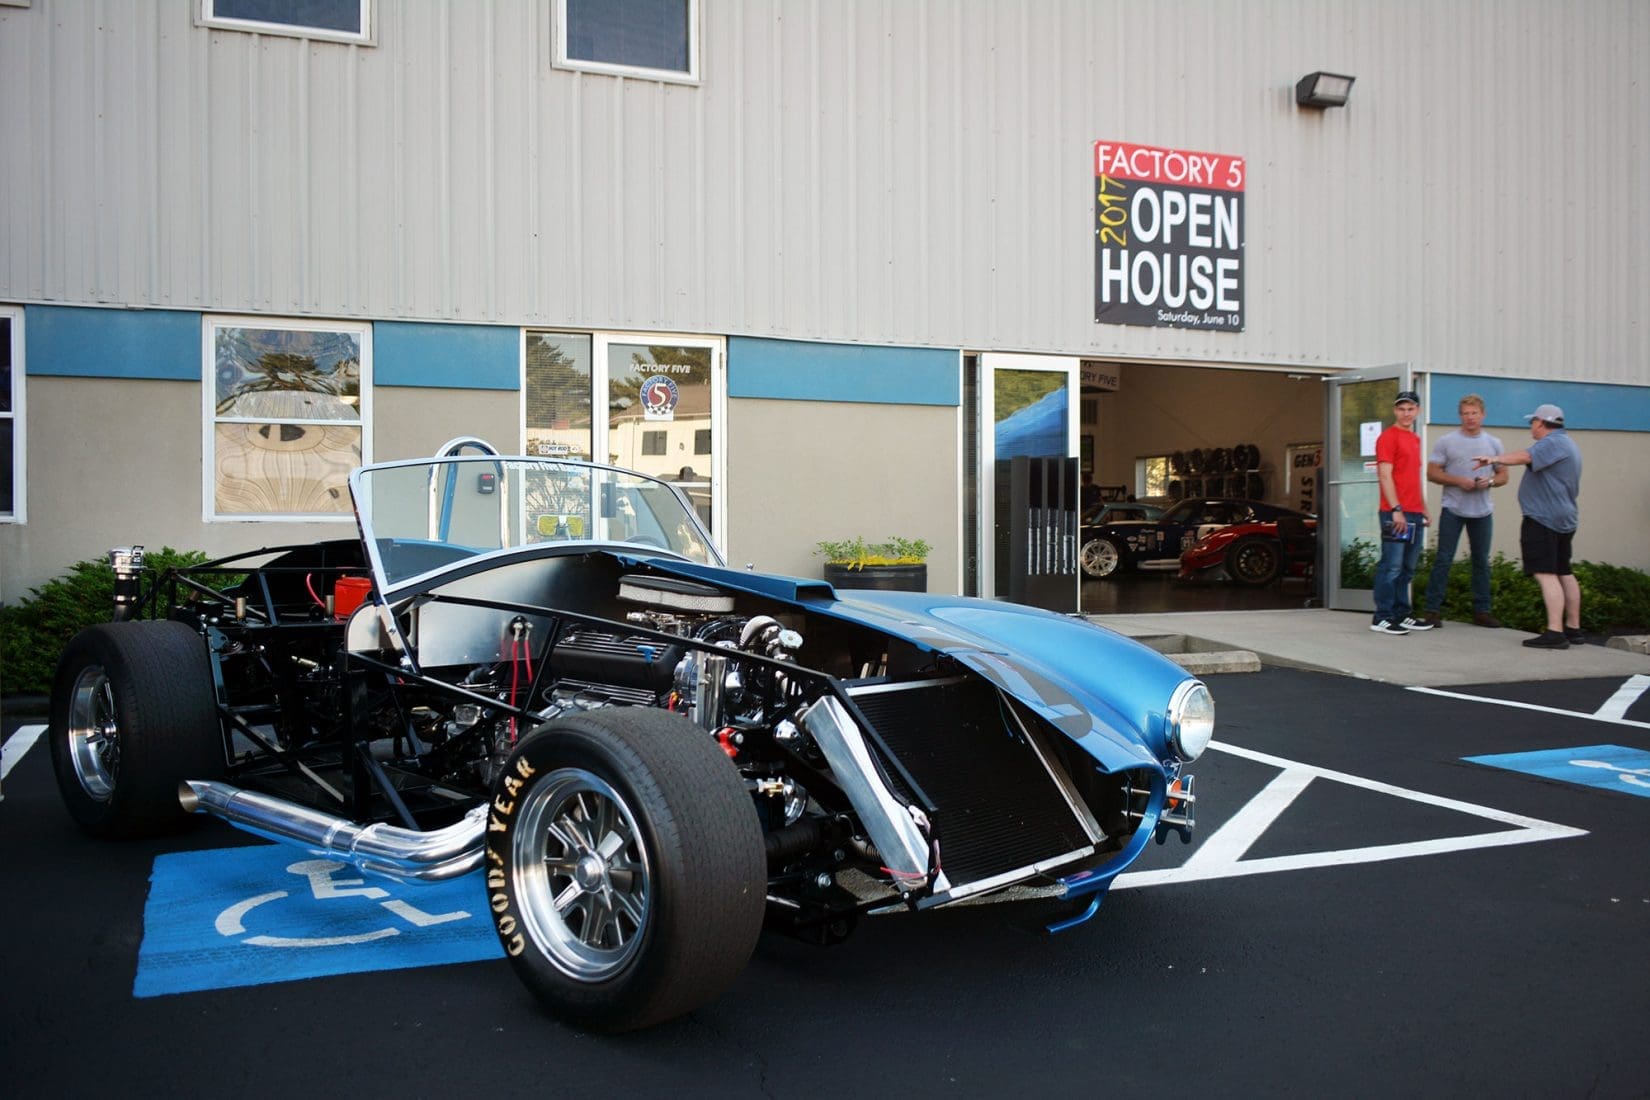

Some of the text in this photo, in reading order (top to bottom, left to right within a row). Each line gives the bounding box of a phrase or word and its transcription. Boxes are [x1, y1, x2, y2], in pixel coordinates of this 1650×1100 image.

[1098, 145, 1242, 188] FACTORY 5
[1098, 173, 1128, 246] 2017
[1131, 187, 1239, 250] OPEN
[1102, 248, 1239, 311] HOUSE
[1157, 309, 1240, 326] Saturday, June 10
[630, 363, 691, 374] FACTORY FIVE
[1098, 374, 1117, 387] FIVE
[653, 382, 666, 407] 5
